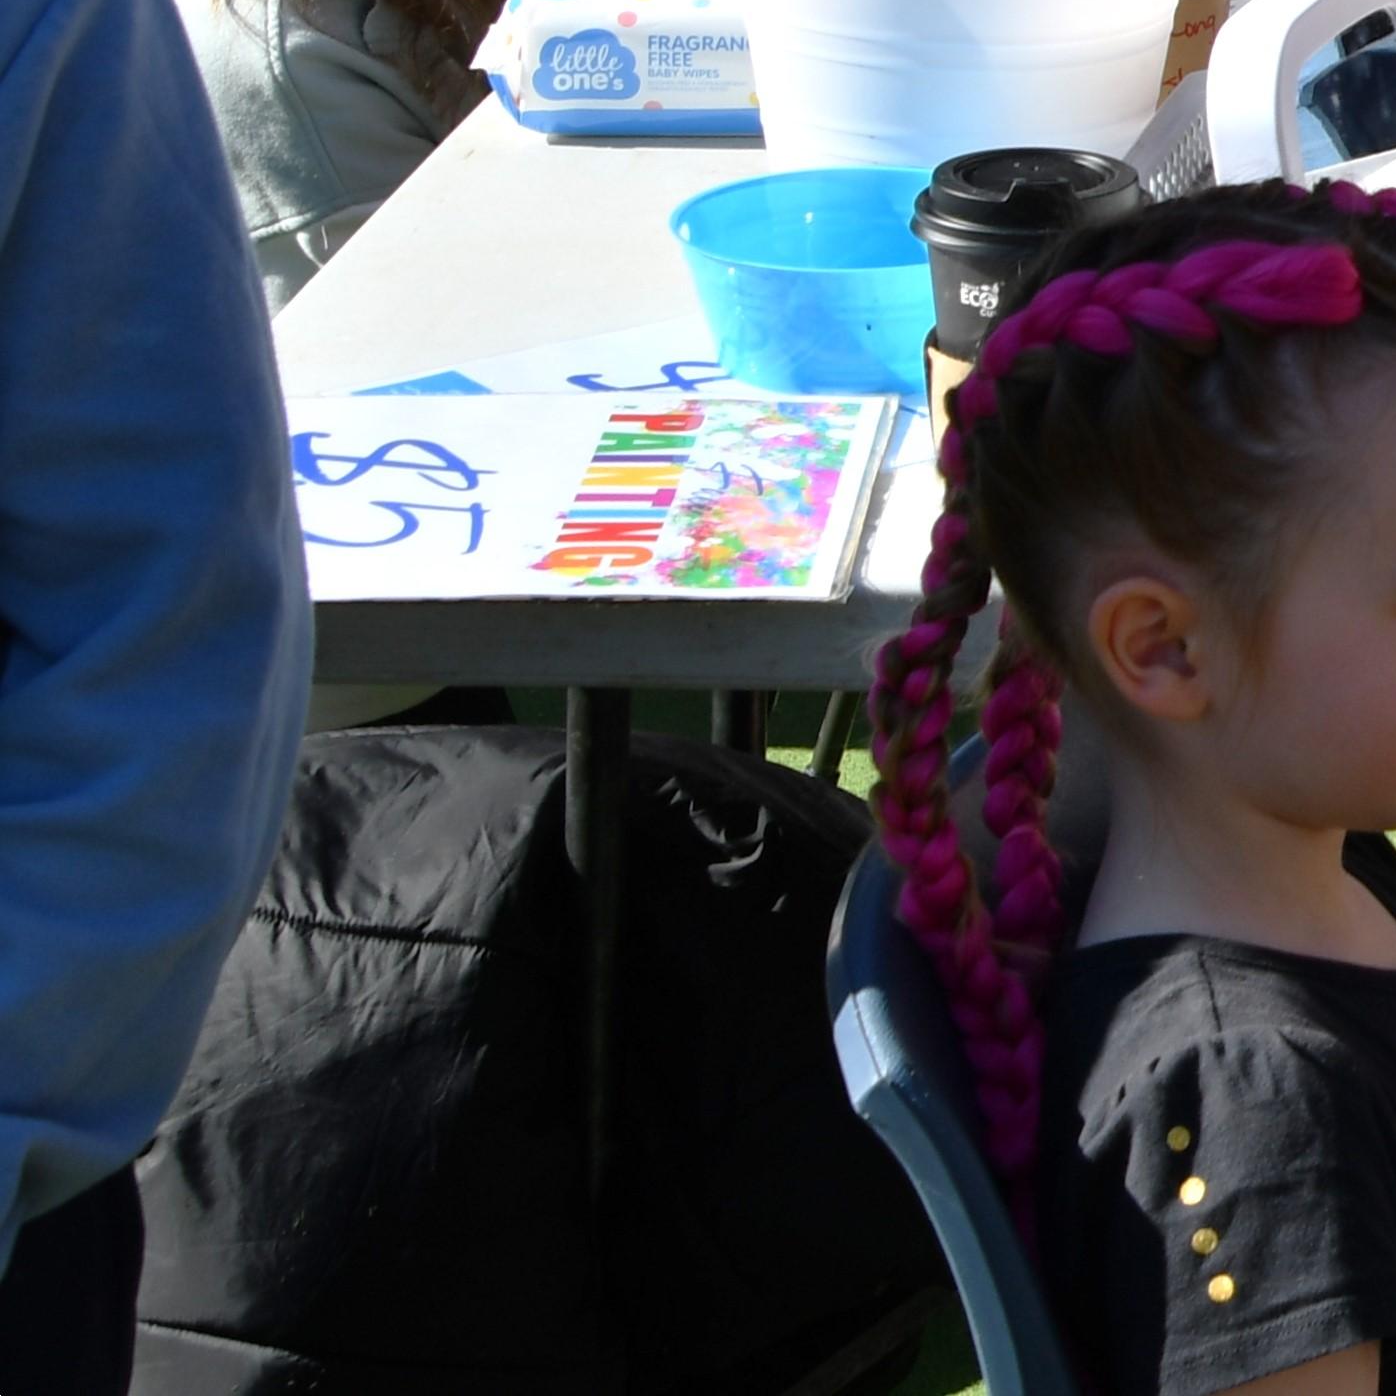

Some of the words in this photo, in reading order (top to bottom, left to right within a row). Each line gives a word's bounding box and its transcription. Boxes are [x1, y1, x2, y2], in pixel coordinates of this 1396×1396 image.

[551, 44, 624, 73] little
[647, 51, 693, 67] FREE
[553, 71, 625, 92] one's
[647, 68, 679, 78] BABY
[683, 68, 720, 79] WIPES
[545, 414, 705, 568] PAINTING
